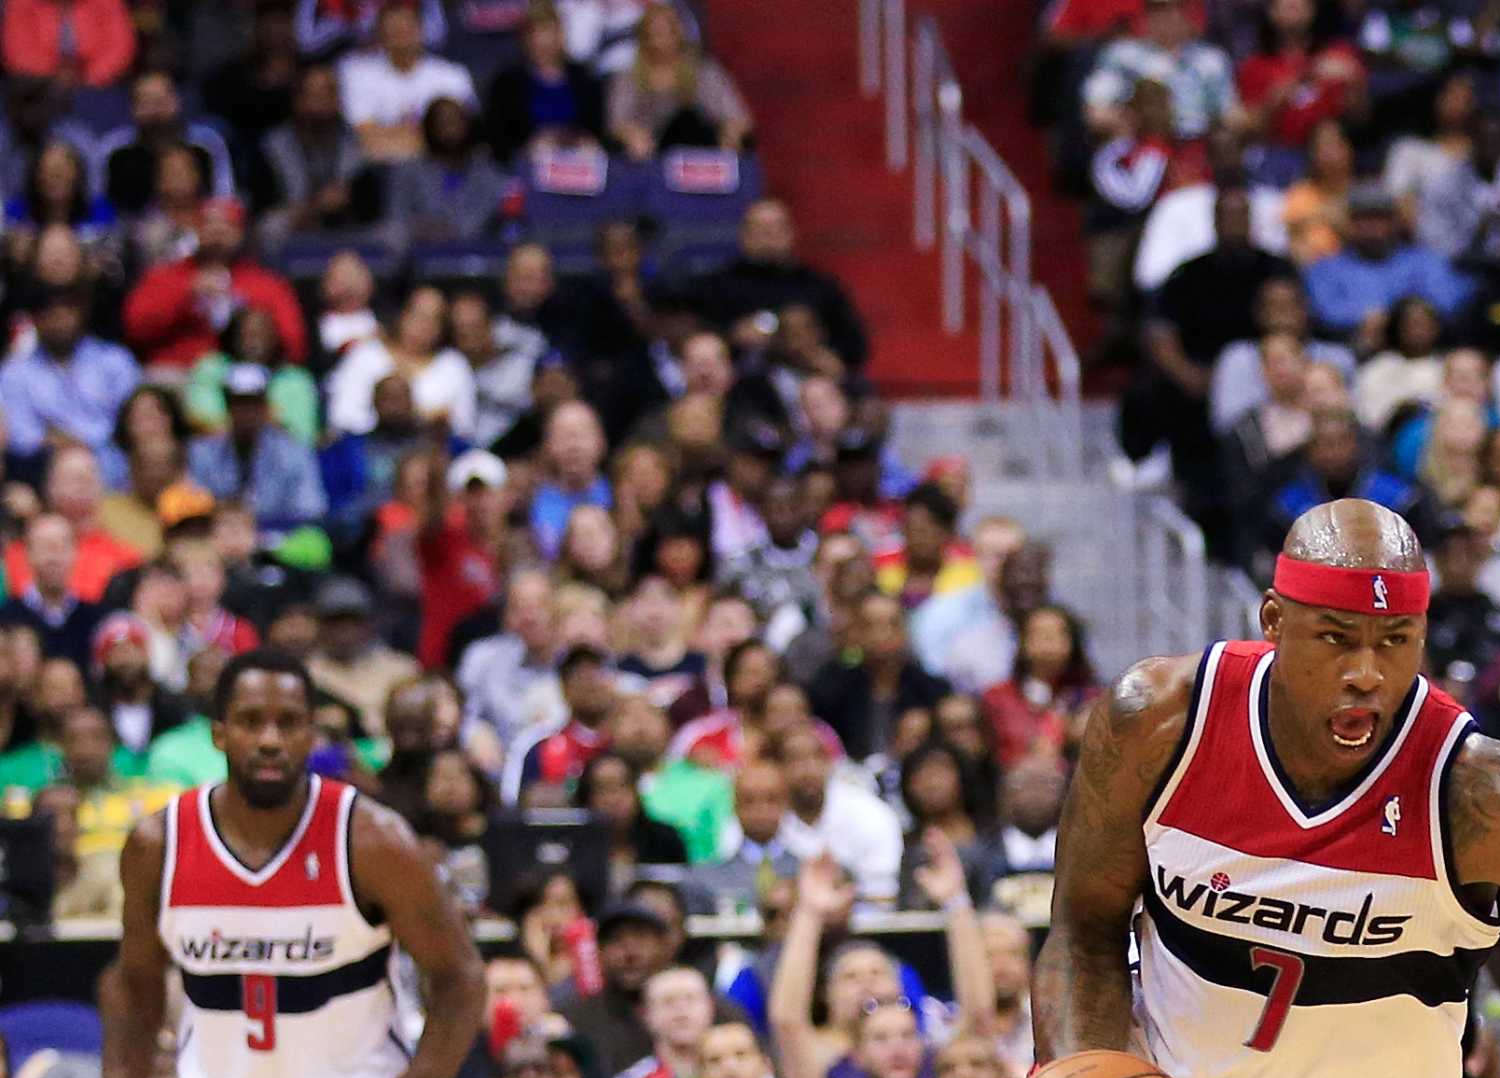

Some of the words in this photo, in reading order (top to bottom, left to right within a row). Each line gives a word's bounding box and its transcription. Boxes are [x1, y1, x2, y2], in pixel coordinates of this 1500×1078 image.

[180, 927, 336, 961] wizards
[1157, 864, 1413, 945] wizards
[243, 972, 278, 1052] 9
[1243, 946, 1305, 1053] 7
